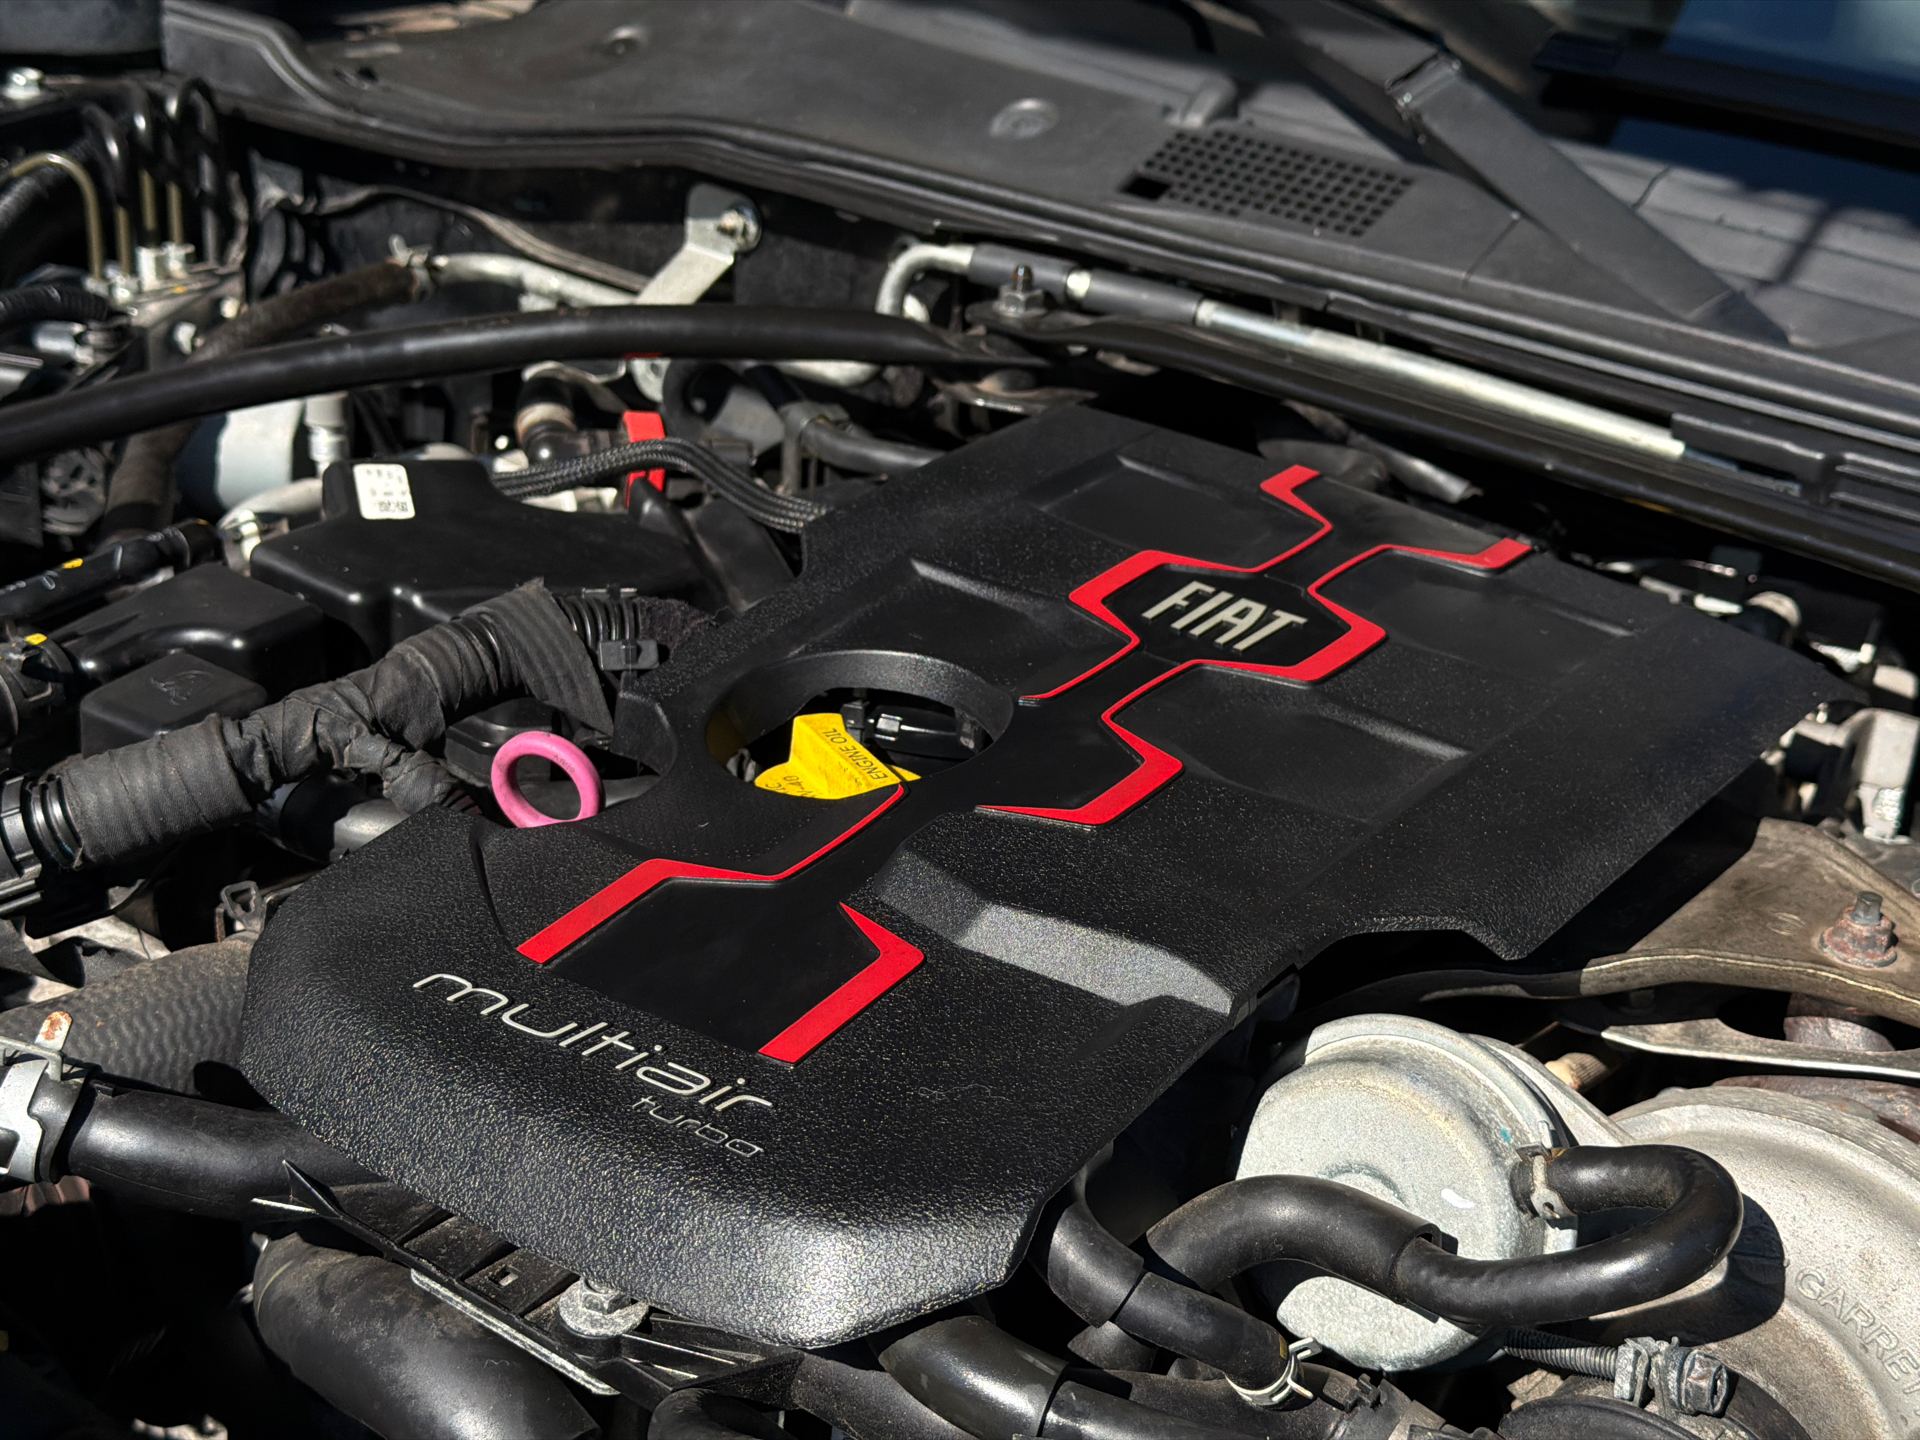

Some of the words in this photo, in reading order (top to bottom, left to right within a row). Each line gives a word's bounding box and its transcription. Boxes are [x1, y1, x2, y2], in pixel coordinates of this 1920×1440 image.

[1141, 580, 1308, 653] FIAT
[822, 727, 848, 744] OIL
[839, 745, 888, 780] ENGINE
[413, 972, 774, 1112] multiair
[1795, 1267, 1920, 1416] GARRE
